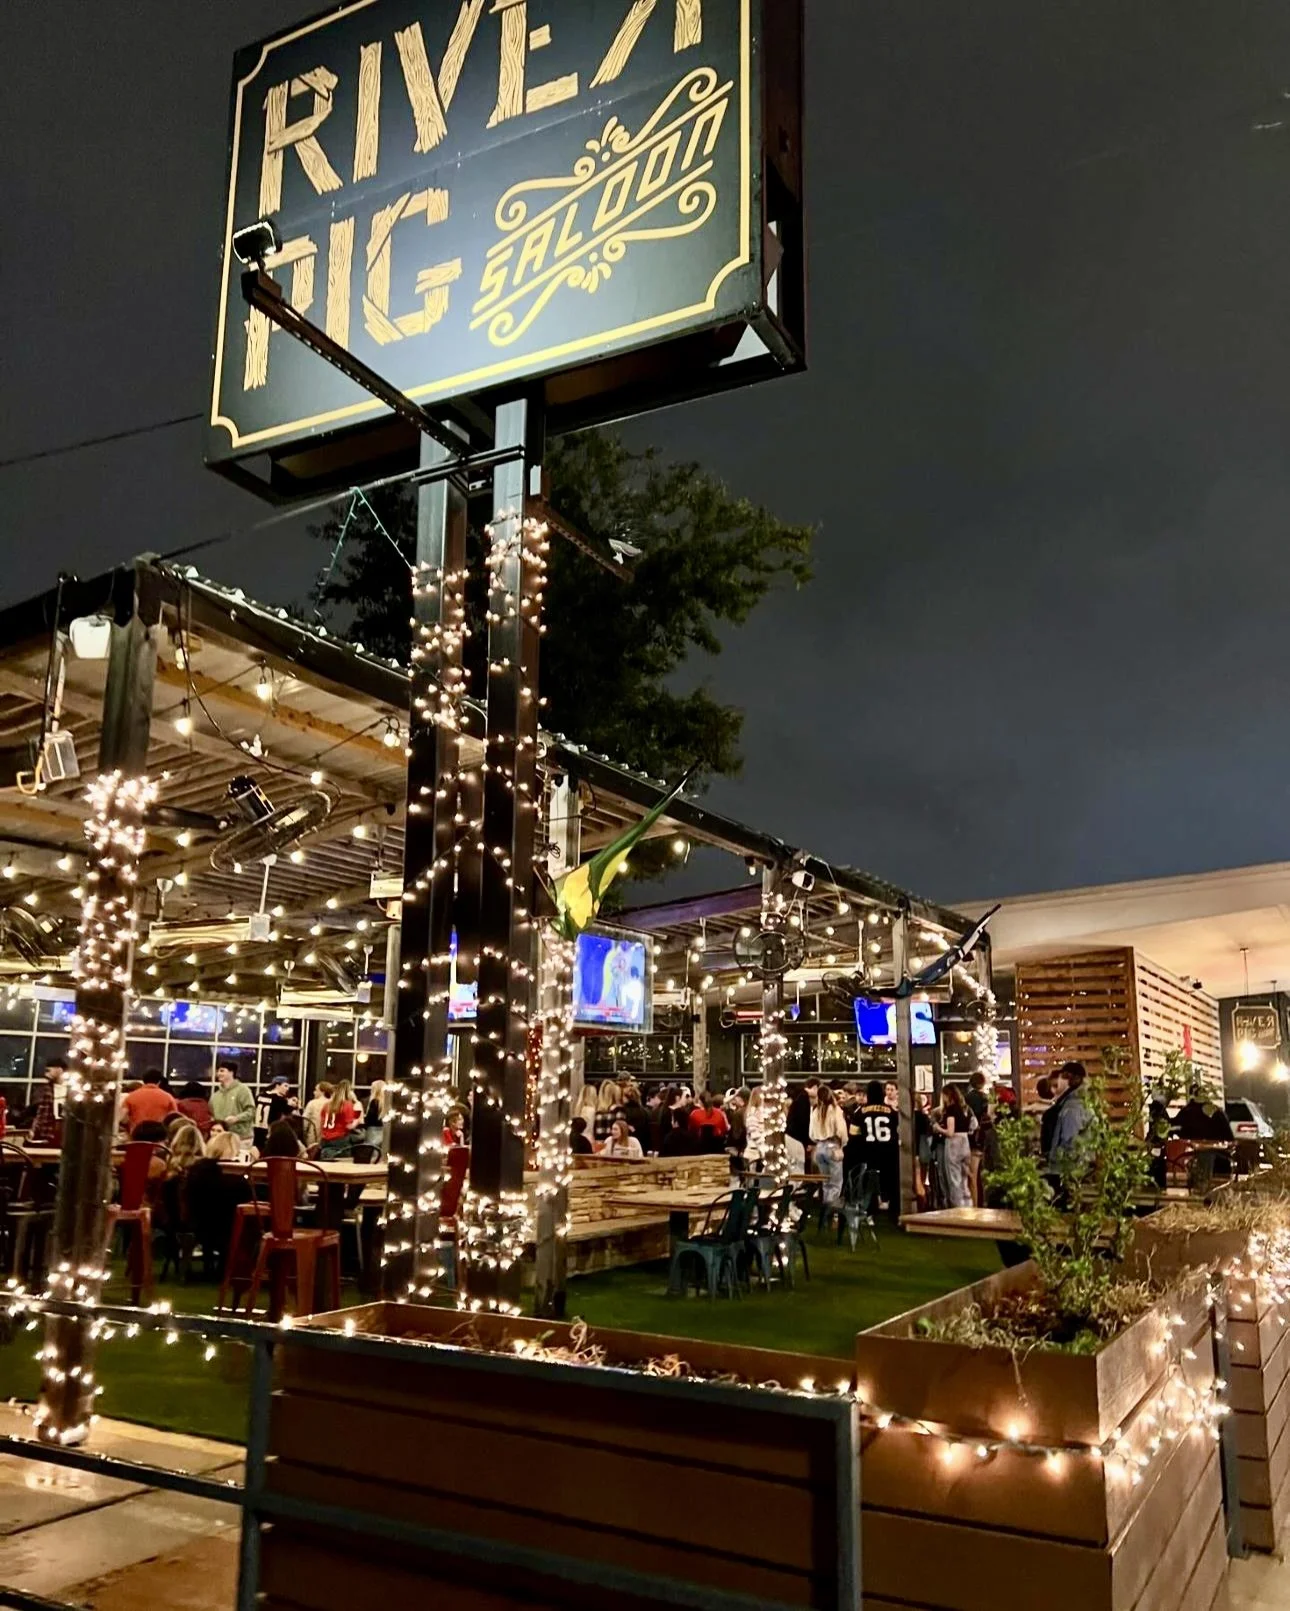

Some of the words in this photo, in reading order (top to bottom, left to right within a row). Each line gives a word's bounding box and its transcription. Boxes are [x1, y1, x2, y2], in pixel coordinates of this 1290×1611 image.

[243, 187, 462, 391] PIG
[472, 98, 728, 314] SALOON
[864, 1116, 891, 1142] 16
